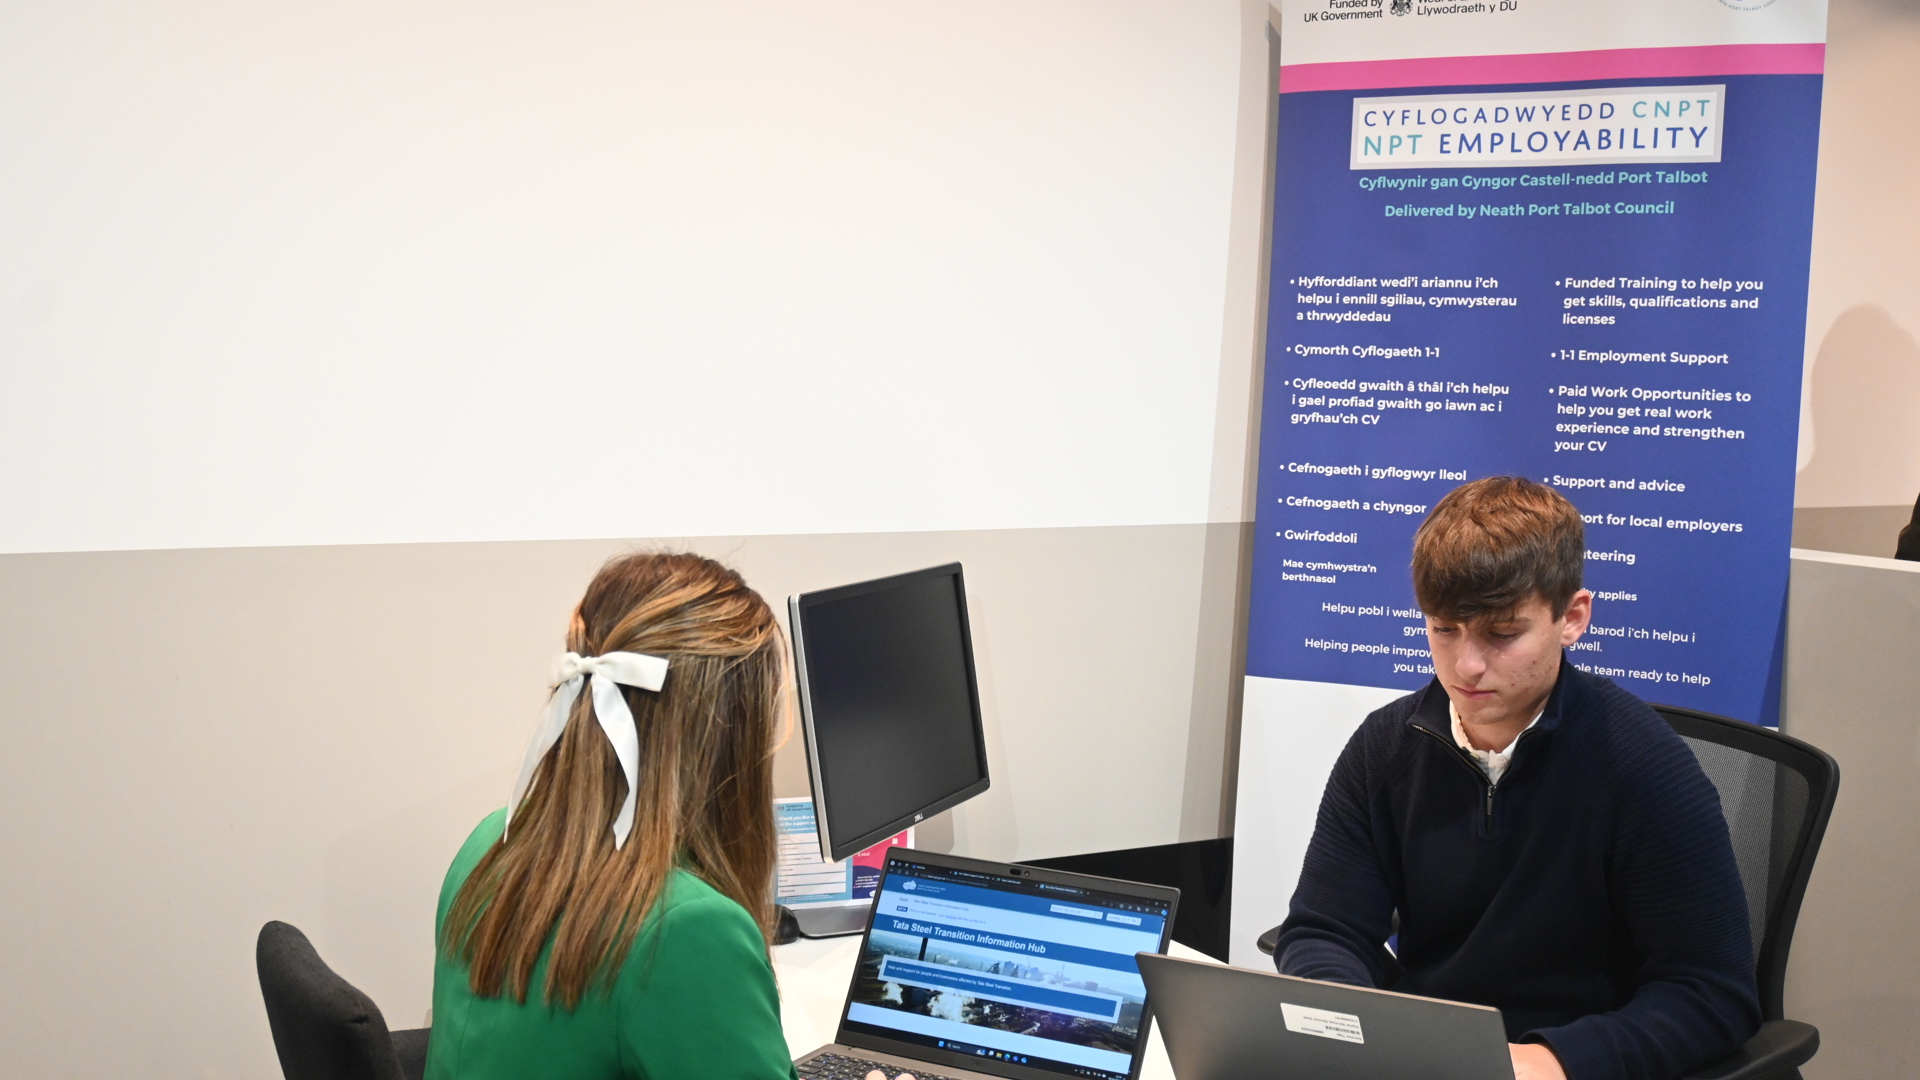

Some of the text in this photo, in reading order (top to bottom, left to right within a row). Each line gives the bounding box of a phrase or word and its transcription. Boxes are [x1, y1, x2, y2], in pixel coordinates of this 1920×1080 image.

[1330, 0, 1383, 8] Funded by
[1418, 0, 1517, 16] Llywodraeth y DU
[1304, 9, 1382, 22] UK Government
[1365, 100, 1710, 126] CYFLOGADWYEDD CNPT
[1364, 127, 1707, 156] NPT EMPLOYABILITY
[1359, 171, 1708, 191] Cyflwynir gan Gyngor Castell-nedd Port Talbot
[1385, 201, 1674, 219] Delivered by Neath Port Talbot Council
[1299, 276, 1498, 288] Hyfforddiant wedi'i ariannu i'ch
[1565, 277, 1763, 292] Funded Training to help you
[1298, 293, 1516, 308] helpu i ennill sgiliau, cymwysterau
[1564, 295, 1758, 309] get skills, qualifications and
[1297, 310, 1390, 323] a thrwyddedau
[1563, 313, 1615, 324] licenses
[1295, 344, 1439, 358] Cymorth Cyflogaeth 1-1
[1561, 350, 1728, 365] 1-1 Employment Support
[1293, 378, 1509, 396] Cyfleoedd gwaith â thâl i'ch helpu
[1559, 385, 1751, 402] Paid Work Opportunities to
[1292, 394, 1502, 412] i gael profiad gwaith go iawn ac i
[1558, 403, 1712, 419] help you get real work
[1291, 412, 1380, 424] gryfhau'ch CV
[1556, 422, 1744, 440] experience and strengthen
[1554, 441, 1607, 452] your CV
[1288, 463, 1466, 481] Cefnogaeth i gyflogwyr lleol
[1553, 475, 1685, 492] Support and advice
[1287, 496, 1427, 515] Cefnogaeth a chyngor
[1607, 514, 1626, 525] for
[1630, 515, 1662, 527] local
[1666, 519, 1742, 533] employers
[1285, 530, 1357, 543] Gwirfoddoli
[1283, 559, 1376, 572] Mae cymhwystra'n
[1583, 550, 1635, 565] teering
[1282, 572, 1335, 583] berthnasol
[1598, 591, 1637, 601] applies
[1322, 602, 1422, 618] Helpu pobl i wella
[1590, 624, 1695, 643] barod i'ch helpu i
[1305, 638, 1431, 658] Helping people improv
[1394, 664, 1437, 675] you tak
[1574, 663, 1710, 686] ole team ready to help
[893, 920, 1046, 954] Tata Steel Transition Information Hub
